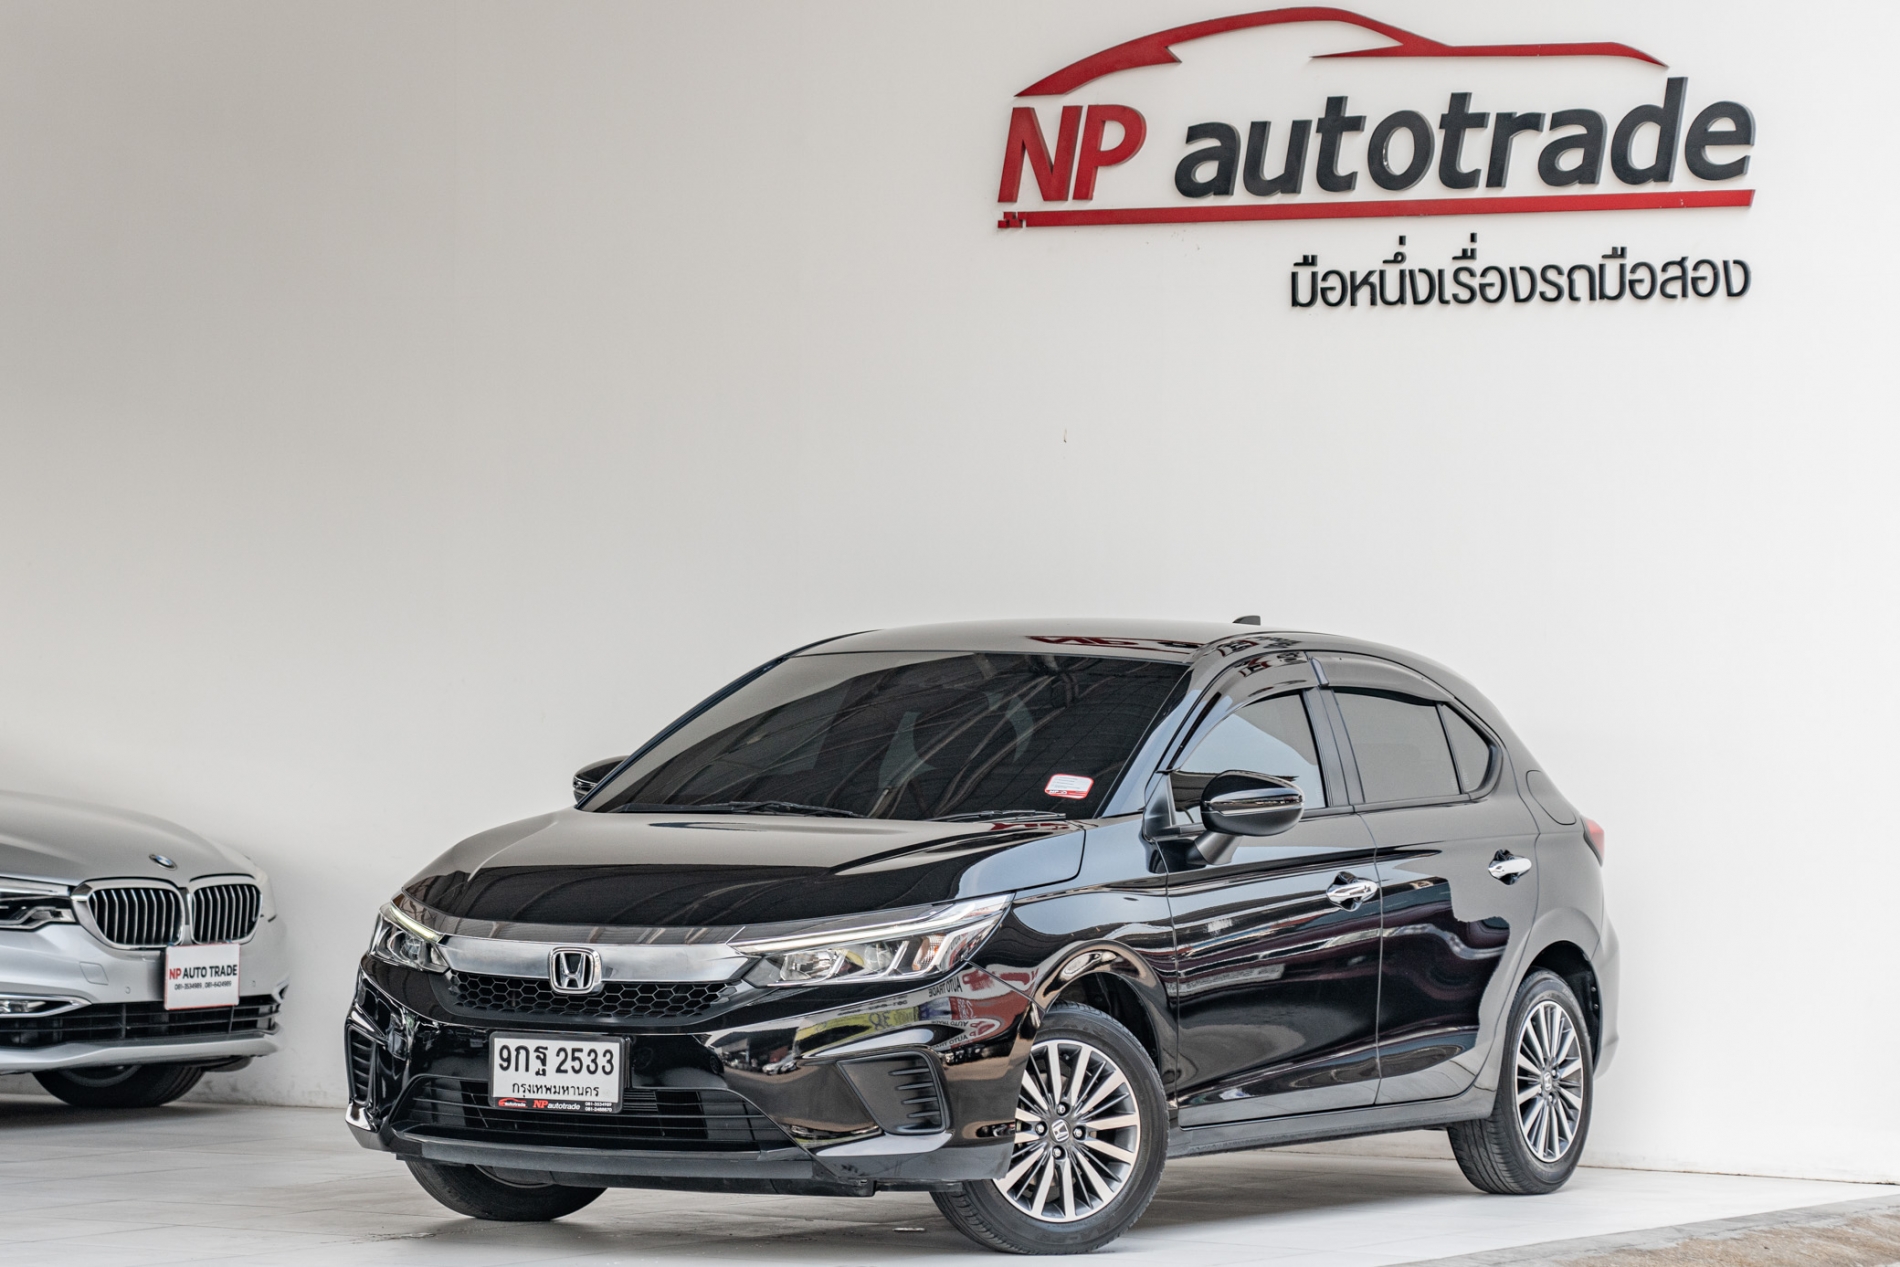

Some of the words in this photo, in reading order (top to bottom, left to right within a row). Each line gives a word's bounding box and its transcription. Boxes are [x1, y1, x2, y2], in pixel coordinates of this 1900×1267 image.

[998, 104, 1147, 203] NP
[1174, 76, 1756, 199] autotrade
[1290, 232, 1751, 308] มือหนึ่งเรื่องรถมือสอง
[169, 968, 182, 980] NP
[183, 966, 208, 979] AUTO
[209, 964, 237, 977] TRADE
[498, 1044, 549, 1077] 9กฐ
[555, 1046, 615, 1076] 2533
[512, 1082, 600, 1098] กรุงเทพมหานคร
[533, 1100, 548, 1109] NP
[547, 1102, 581, 1110] autotrade
